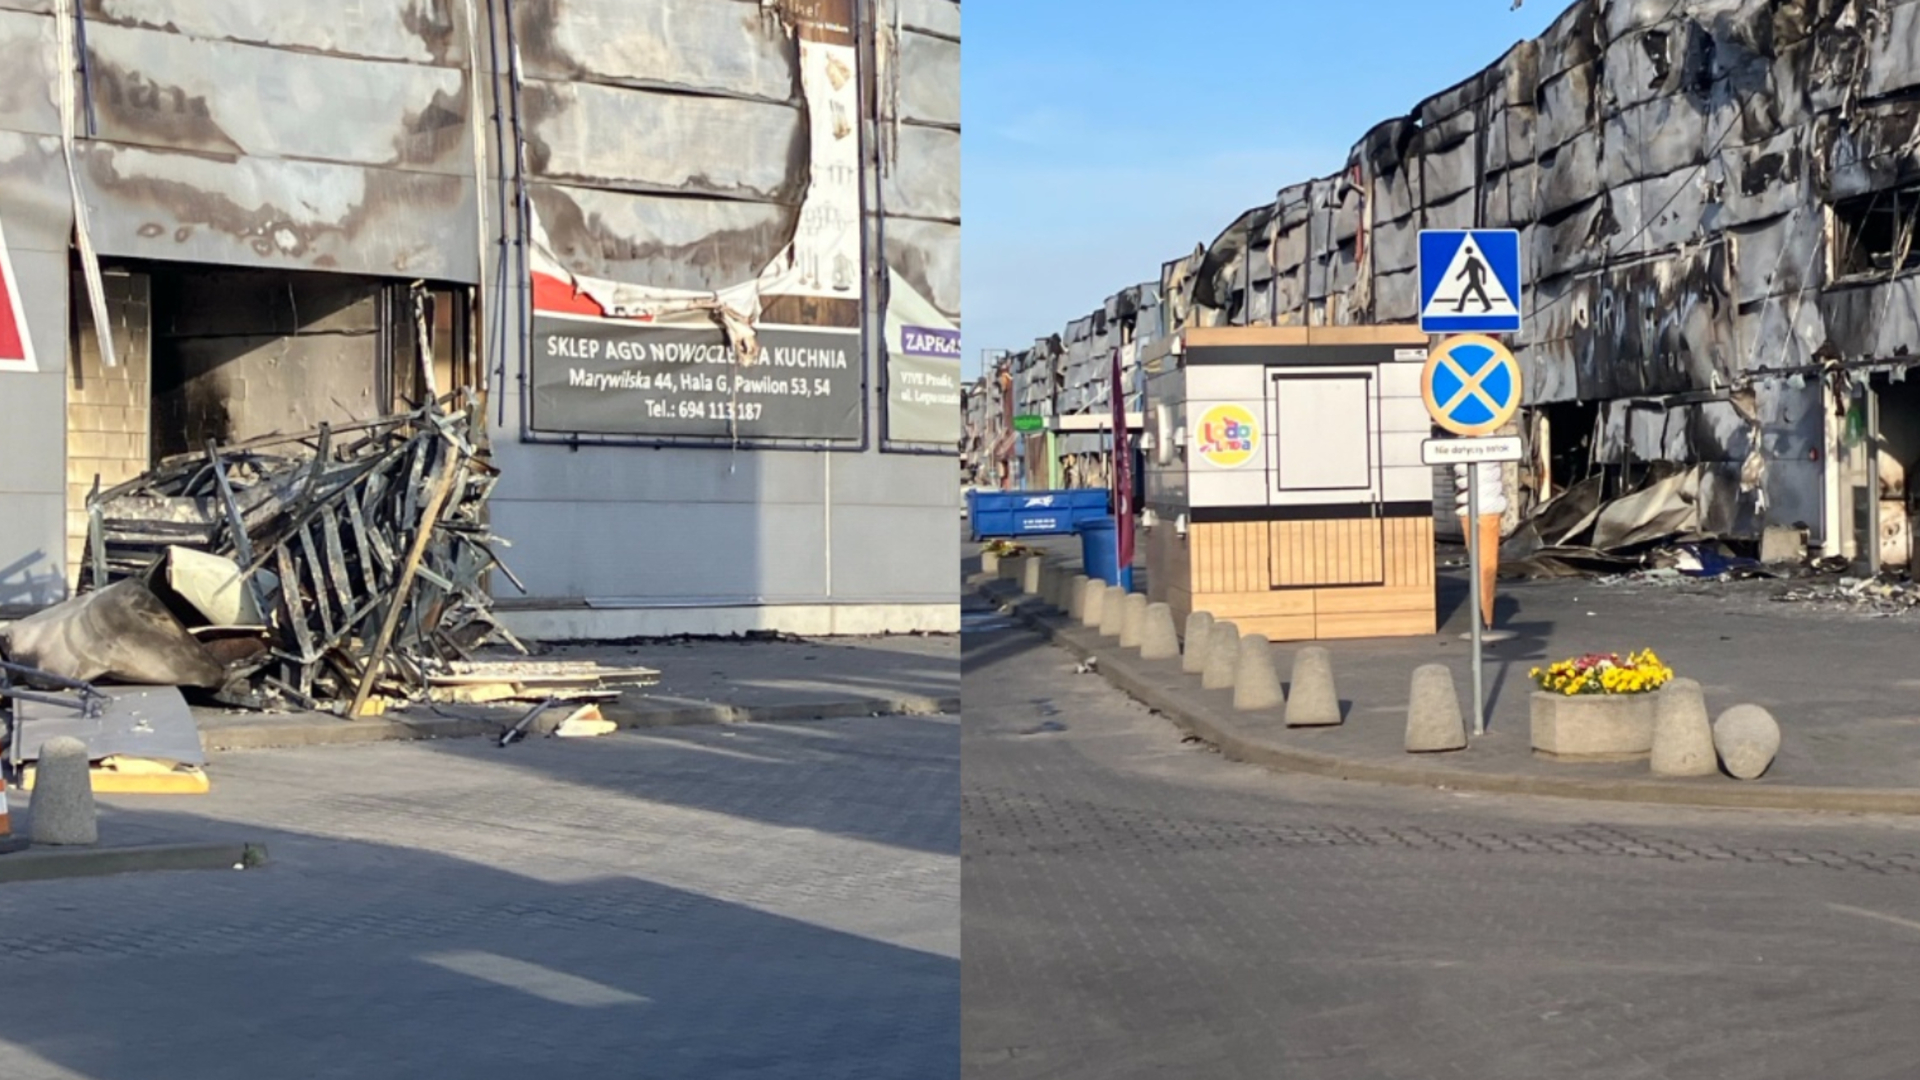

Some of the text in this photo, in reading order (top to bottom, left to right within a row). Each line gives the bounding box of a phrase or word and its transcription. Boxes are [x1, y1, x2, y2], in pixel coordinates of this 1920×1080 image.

[547, 335, 848, 369] SKLEP AGD NOWOCZEA KUCHNIA
[654, 372, 678, 393] 44,
[680, 372, 713, 391] Hala
[716, 375, 732, 395] G,
[735, 375, 788, 394] Pawilon
[790, 377, 812, 398] 53,
[814, 378, 831, 396] 54
[645, 399, 676, 418] Tel.:
[678, 400, 705, 419] 694
[738, 403, 762, 420] 187
